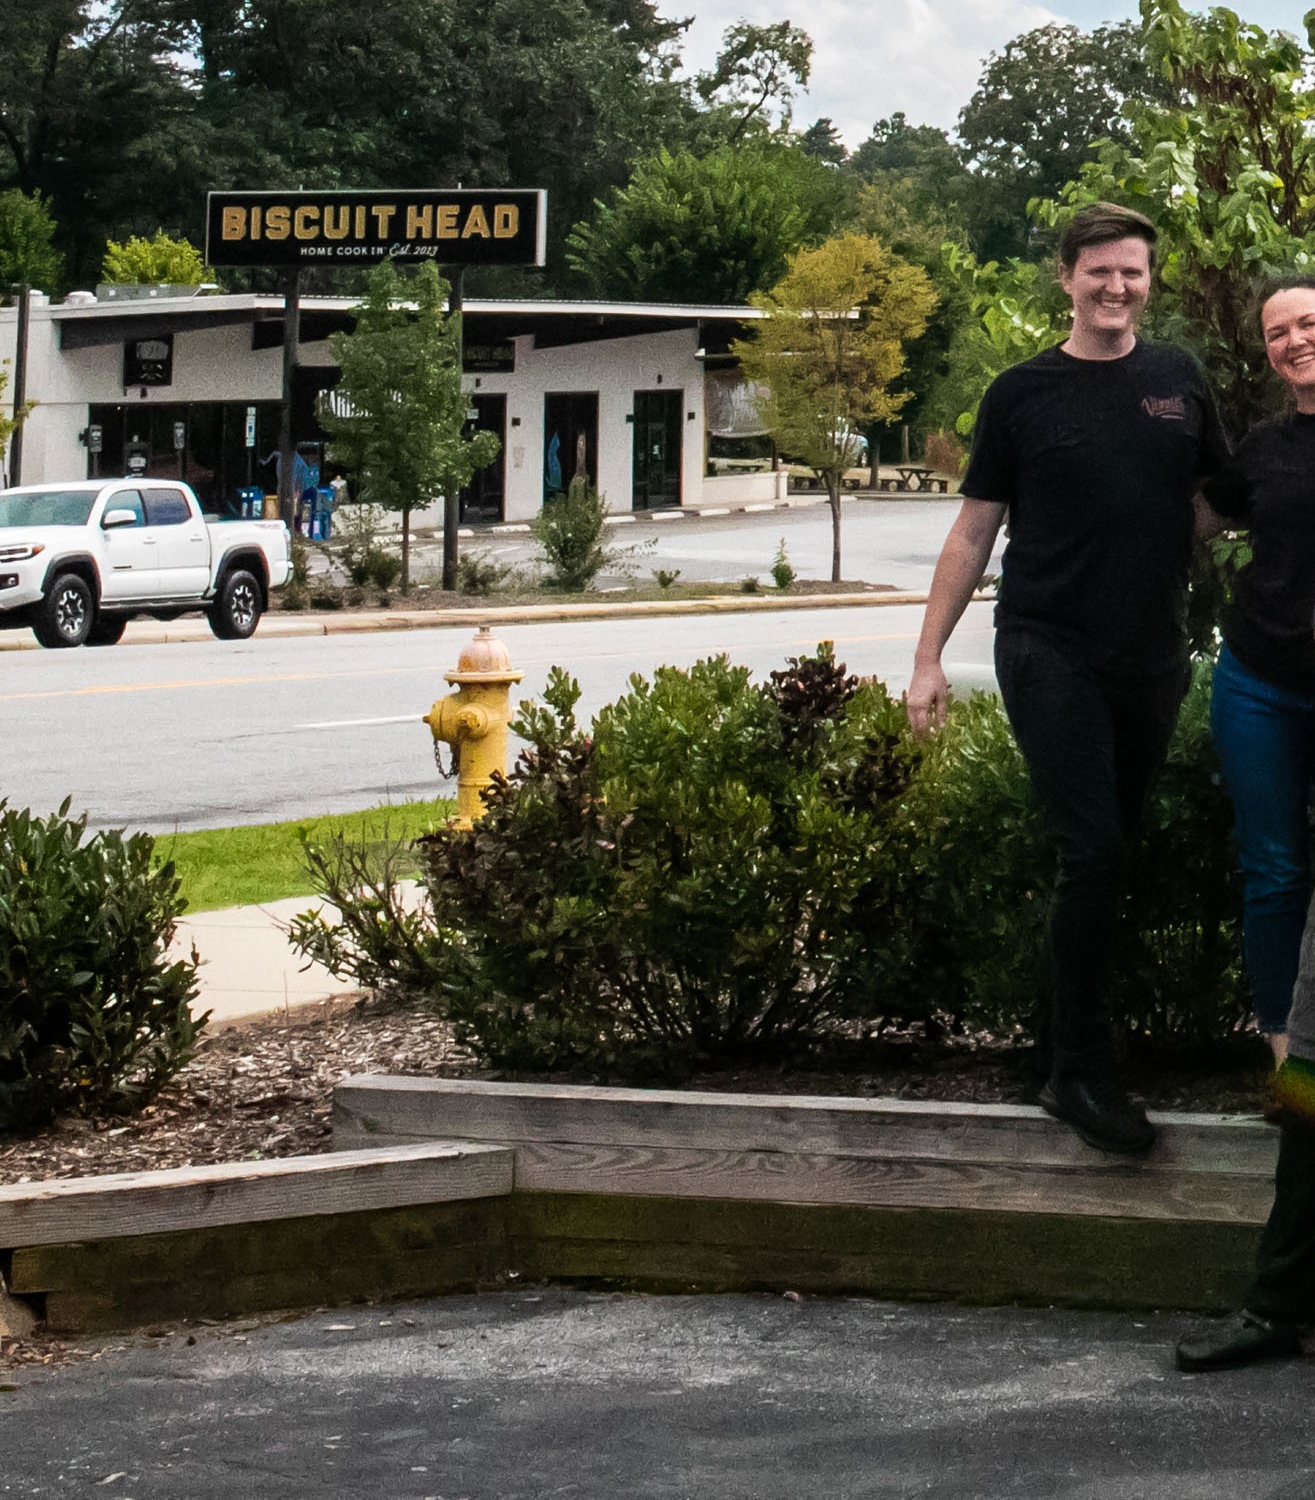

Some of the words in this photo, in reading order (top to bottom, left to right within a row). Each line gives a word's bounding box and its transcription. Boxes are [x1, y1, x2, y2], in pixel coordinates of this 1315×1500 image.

[221, 205, 397, 241] BISCUIT
[406, 204, 520, 239] HEAD
[300, 246, 333, 256] HOME
